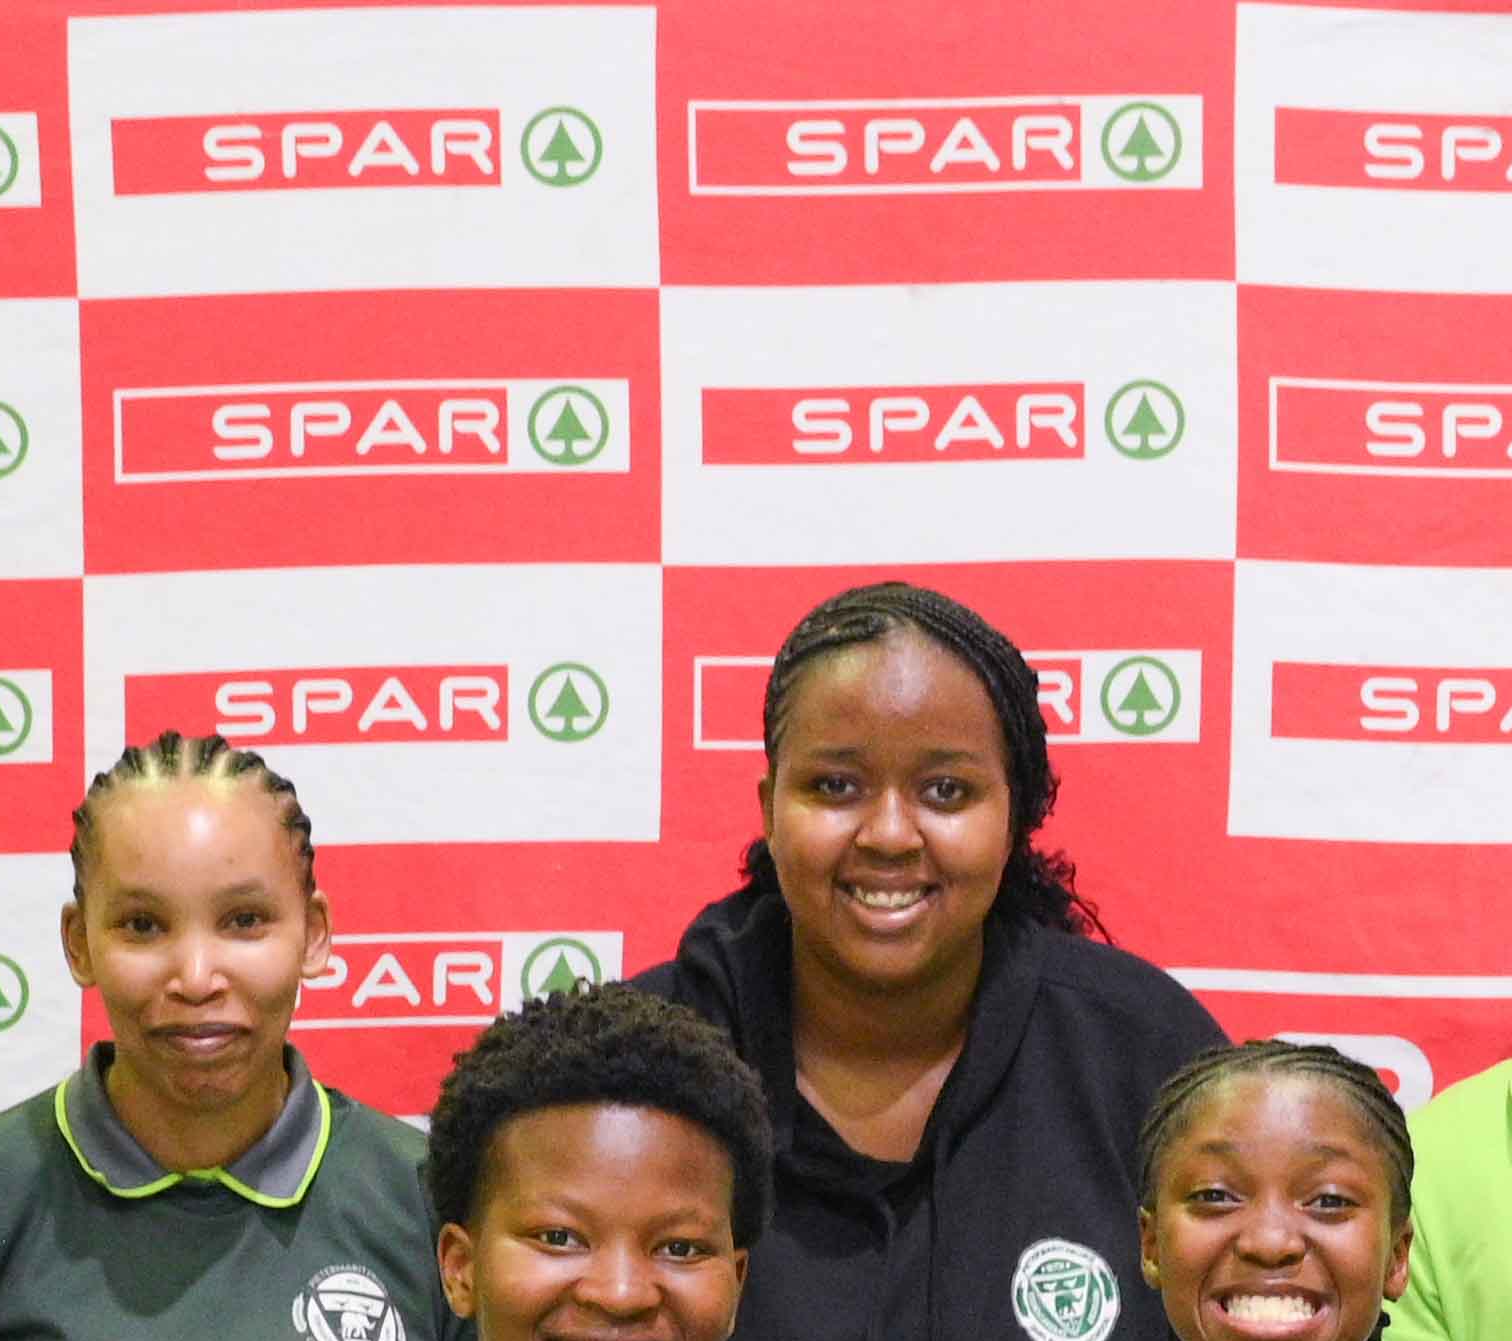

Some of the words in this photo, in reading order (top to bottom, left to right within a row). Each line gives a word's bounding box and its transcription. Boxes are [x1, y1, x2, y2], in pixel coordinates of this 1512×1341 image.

[204, 121, 493, 180] SPAR
[787, 116, 1073, 175] SPAR
[213, 400, 500, 459] SPAR
[793, 395, 1077, 452] SPAR
[216, 677, 500, 737] SPAR
[295, 952, 494, 1008] PAR
